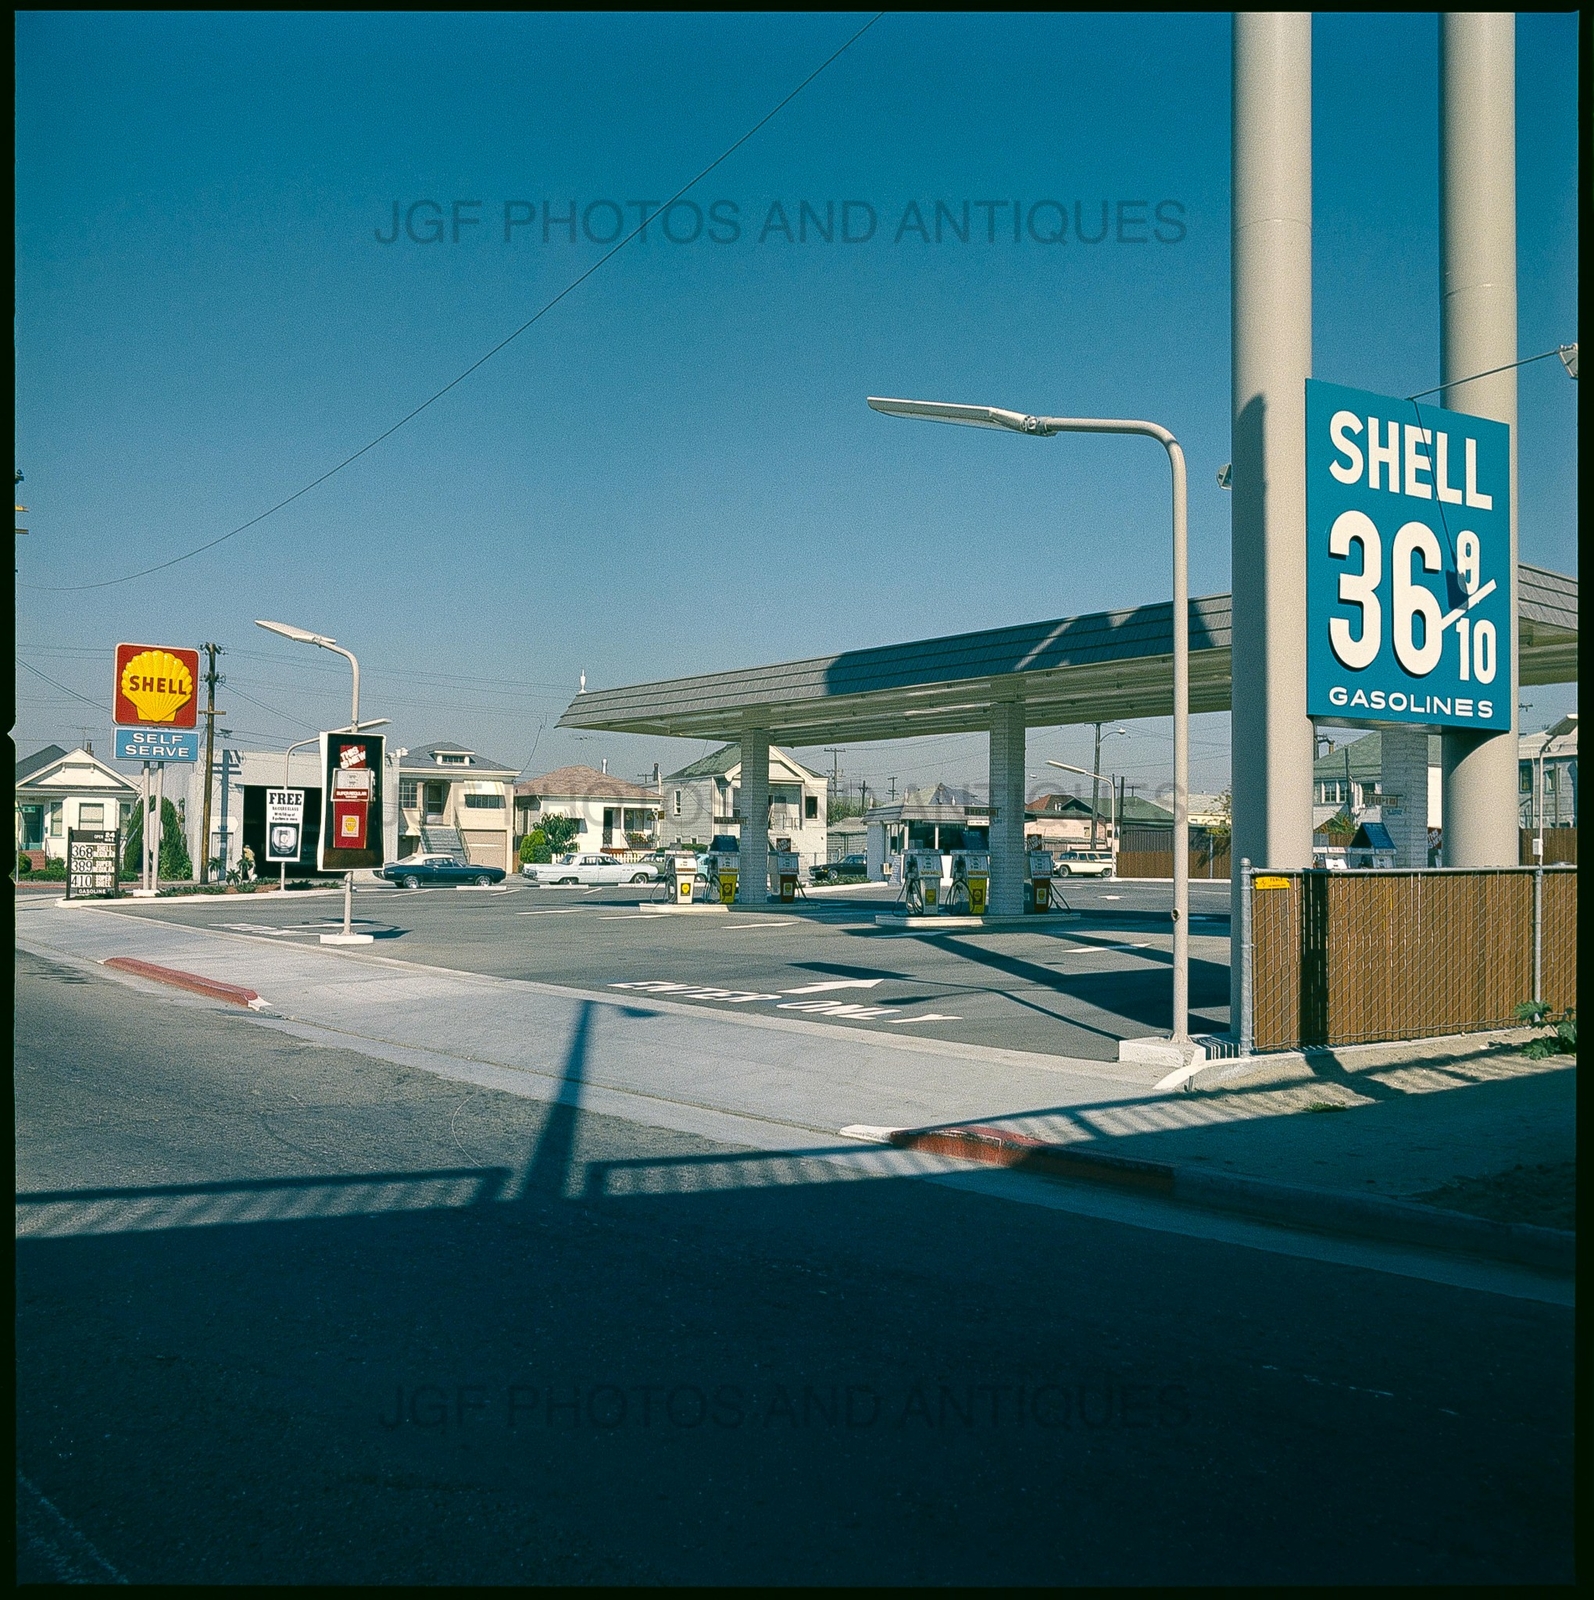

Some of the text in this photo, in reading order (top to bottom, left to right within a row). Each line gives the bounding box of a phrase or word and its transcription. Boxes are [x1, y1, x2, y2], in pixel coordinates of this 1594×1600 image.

[1328, 410, 1493, 510] SHELL
[1328, 510, 1443, 679] 36
[129, 675, 187, 696] SHELL
[1328, 686, 1494, 719] GASOLINES
[132, 732, 184, 745] SELF
[125, 744, 190, 758] SERVE
[269, 792, 302, 805] FREE
[72, 845, 93, 859] 368
[71, 861, 93, 872] 389
[71, 875, 92, 887] 410
[607, 980, 783, 1003] ENTER
[776, 1000, 963, 1024] ONLY
